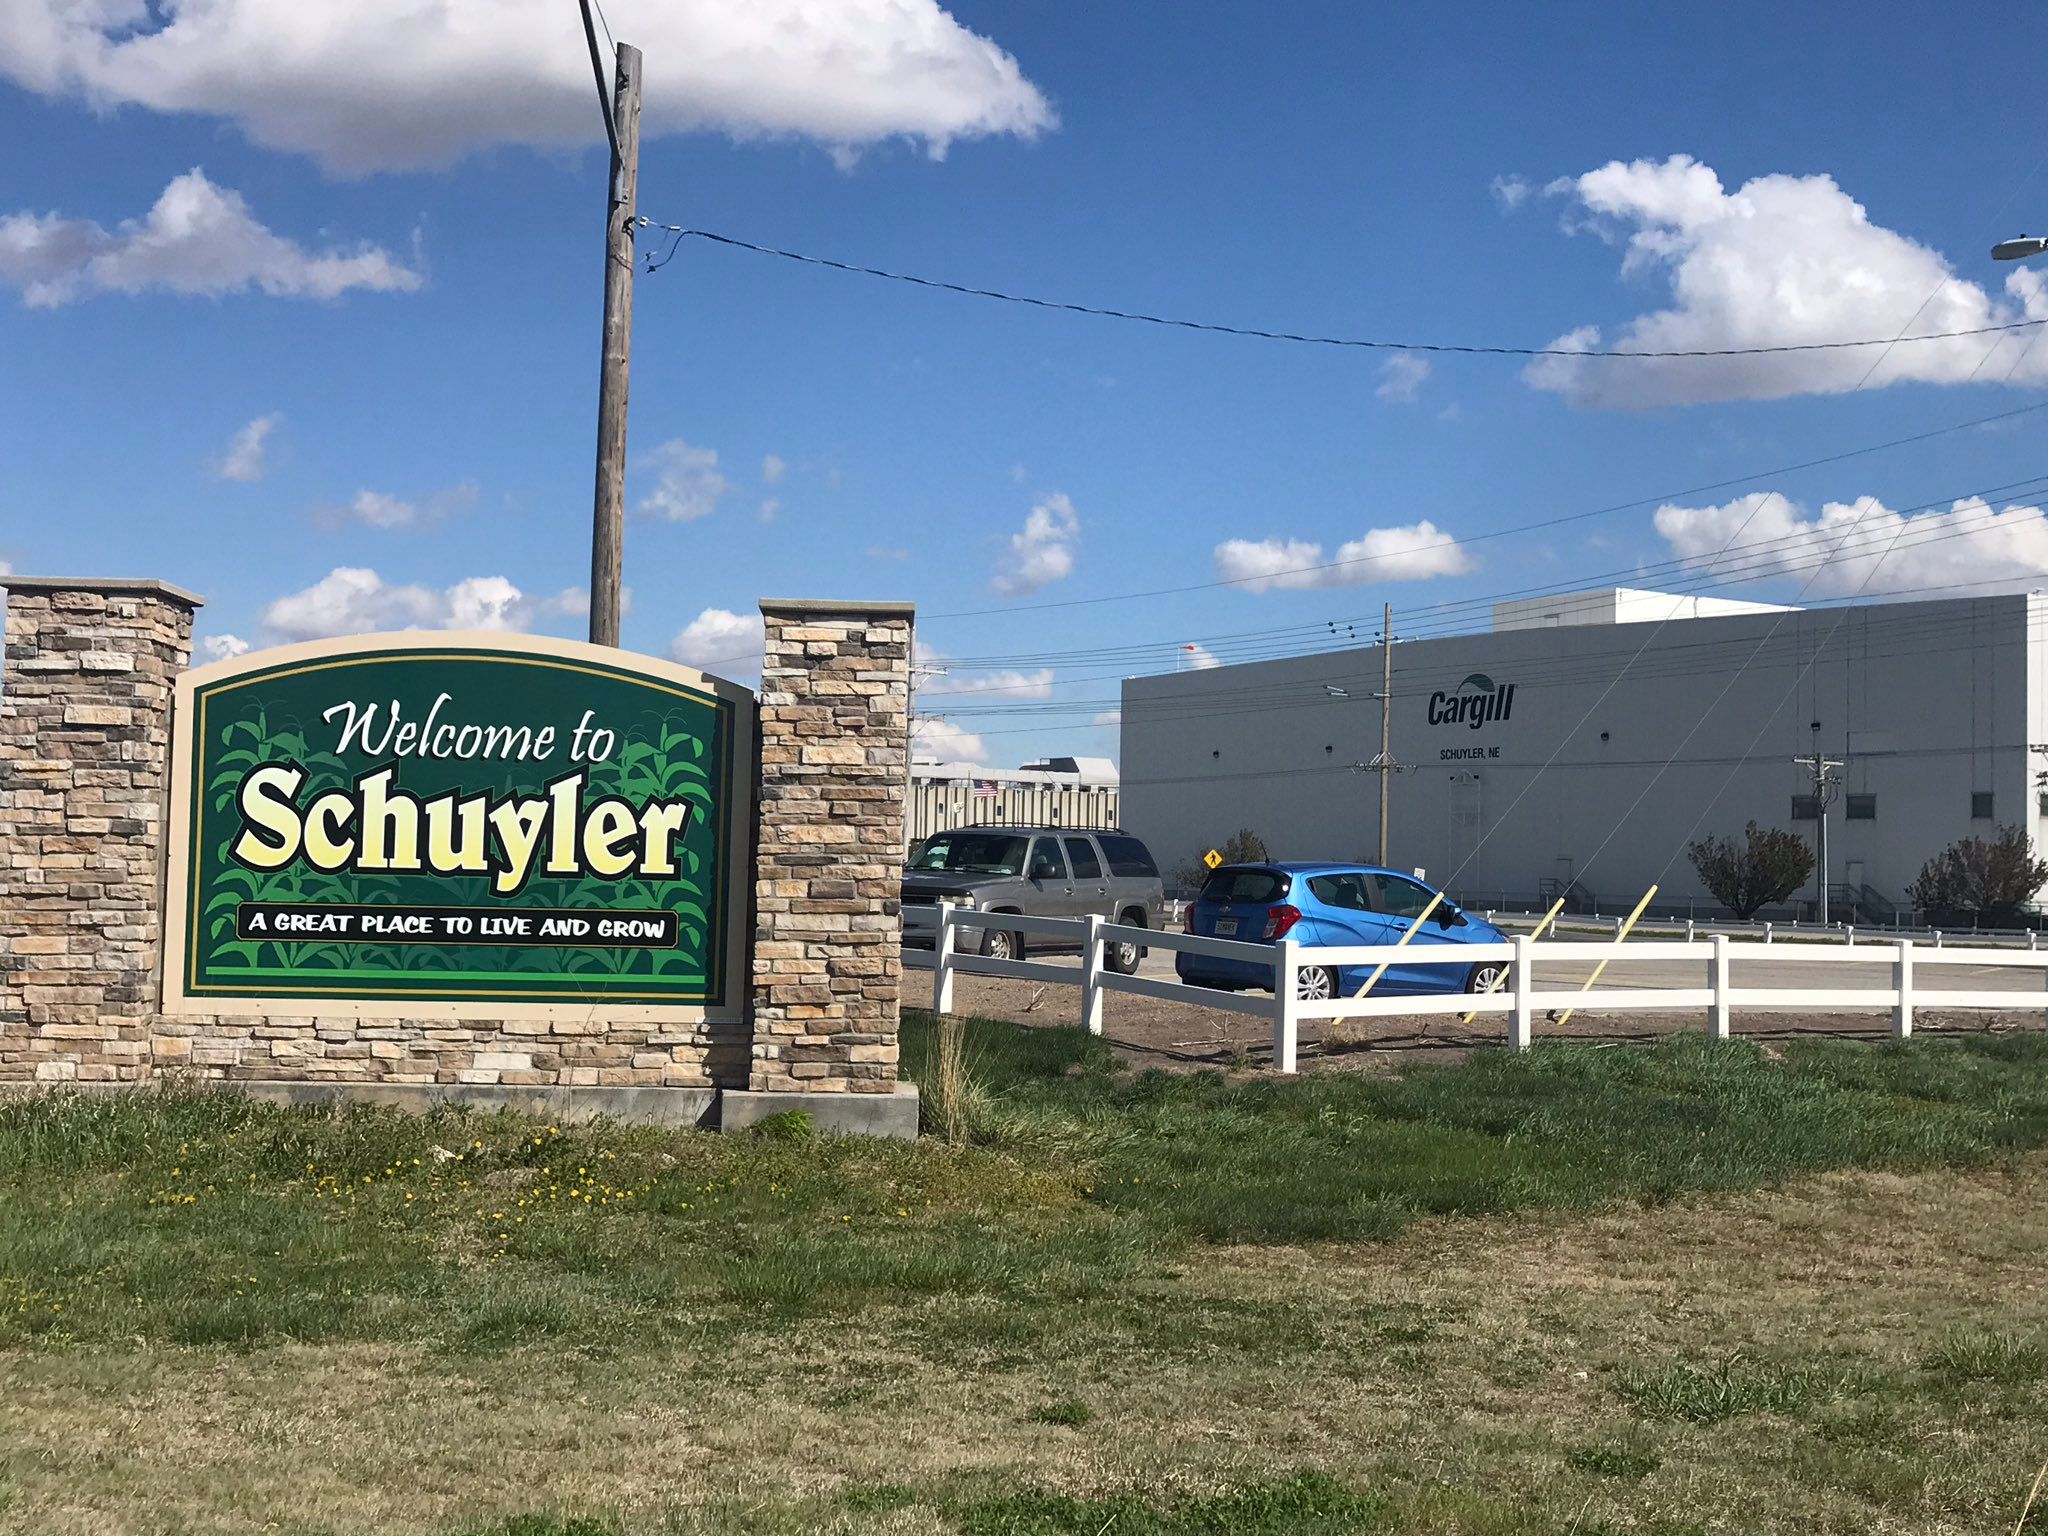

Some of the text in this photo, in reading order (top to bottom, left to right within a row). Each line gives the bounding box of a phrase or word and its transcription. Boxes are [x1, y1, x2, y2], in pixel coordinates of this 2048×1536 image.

[323, 692, 615, 762] Welcome to
[1428, 683, 1515, 730] Cargill
[1440, 746, 1500, 760] SCHUYLER, NE
[234, 765, 687, 893] Schuyler
[248, 912, 665, 938] A GREAT PLACE TO LIVE AND GROW
